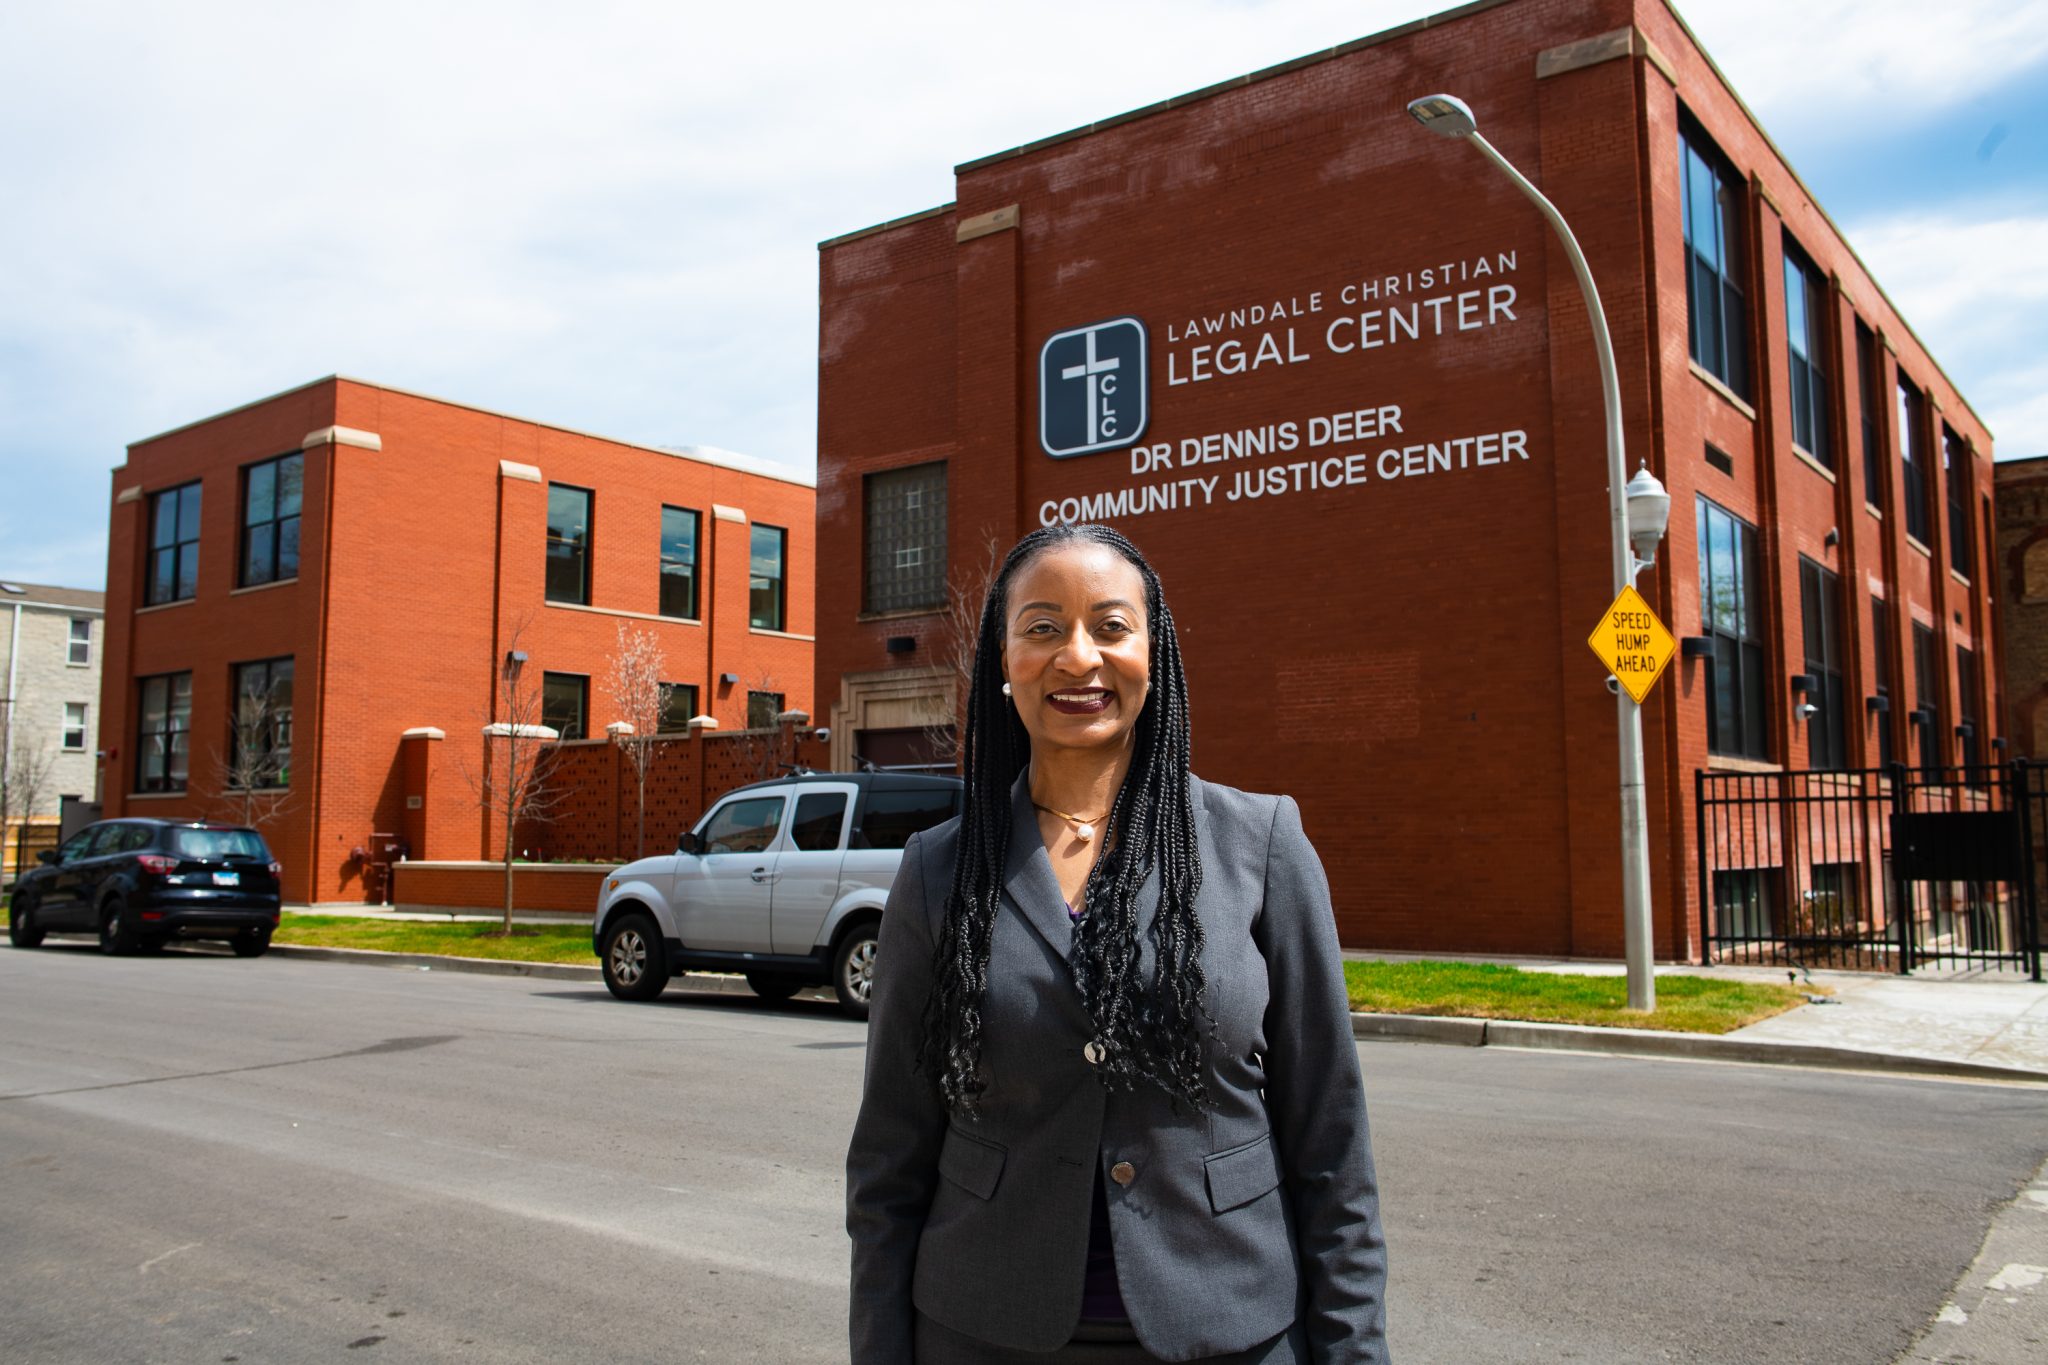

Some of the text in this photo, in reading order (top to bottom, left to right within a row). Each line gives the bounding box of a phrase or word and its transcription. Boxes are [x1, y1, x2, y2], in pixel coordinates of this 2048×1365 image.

[1167, 249, 1517, 342] LAWNDALE CHRISTIAN
[1168, 284, 1517, 386] LEGAL CENTER
[1130, 404, 1404, 475] DR DENNIS DEER
[1039, 429, 1530, 527] COMMUNITY JUSTICE CENTER
[1612, 611, 1651, 630] SPEED
[1616, 633, 1651, 651] HUMP
[1615, 655, 1656, 673] AHEAD
